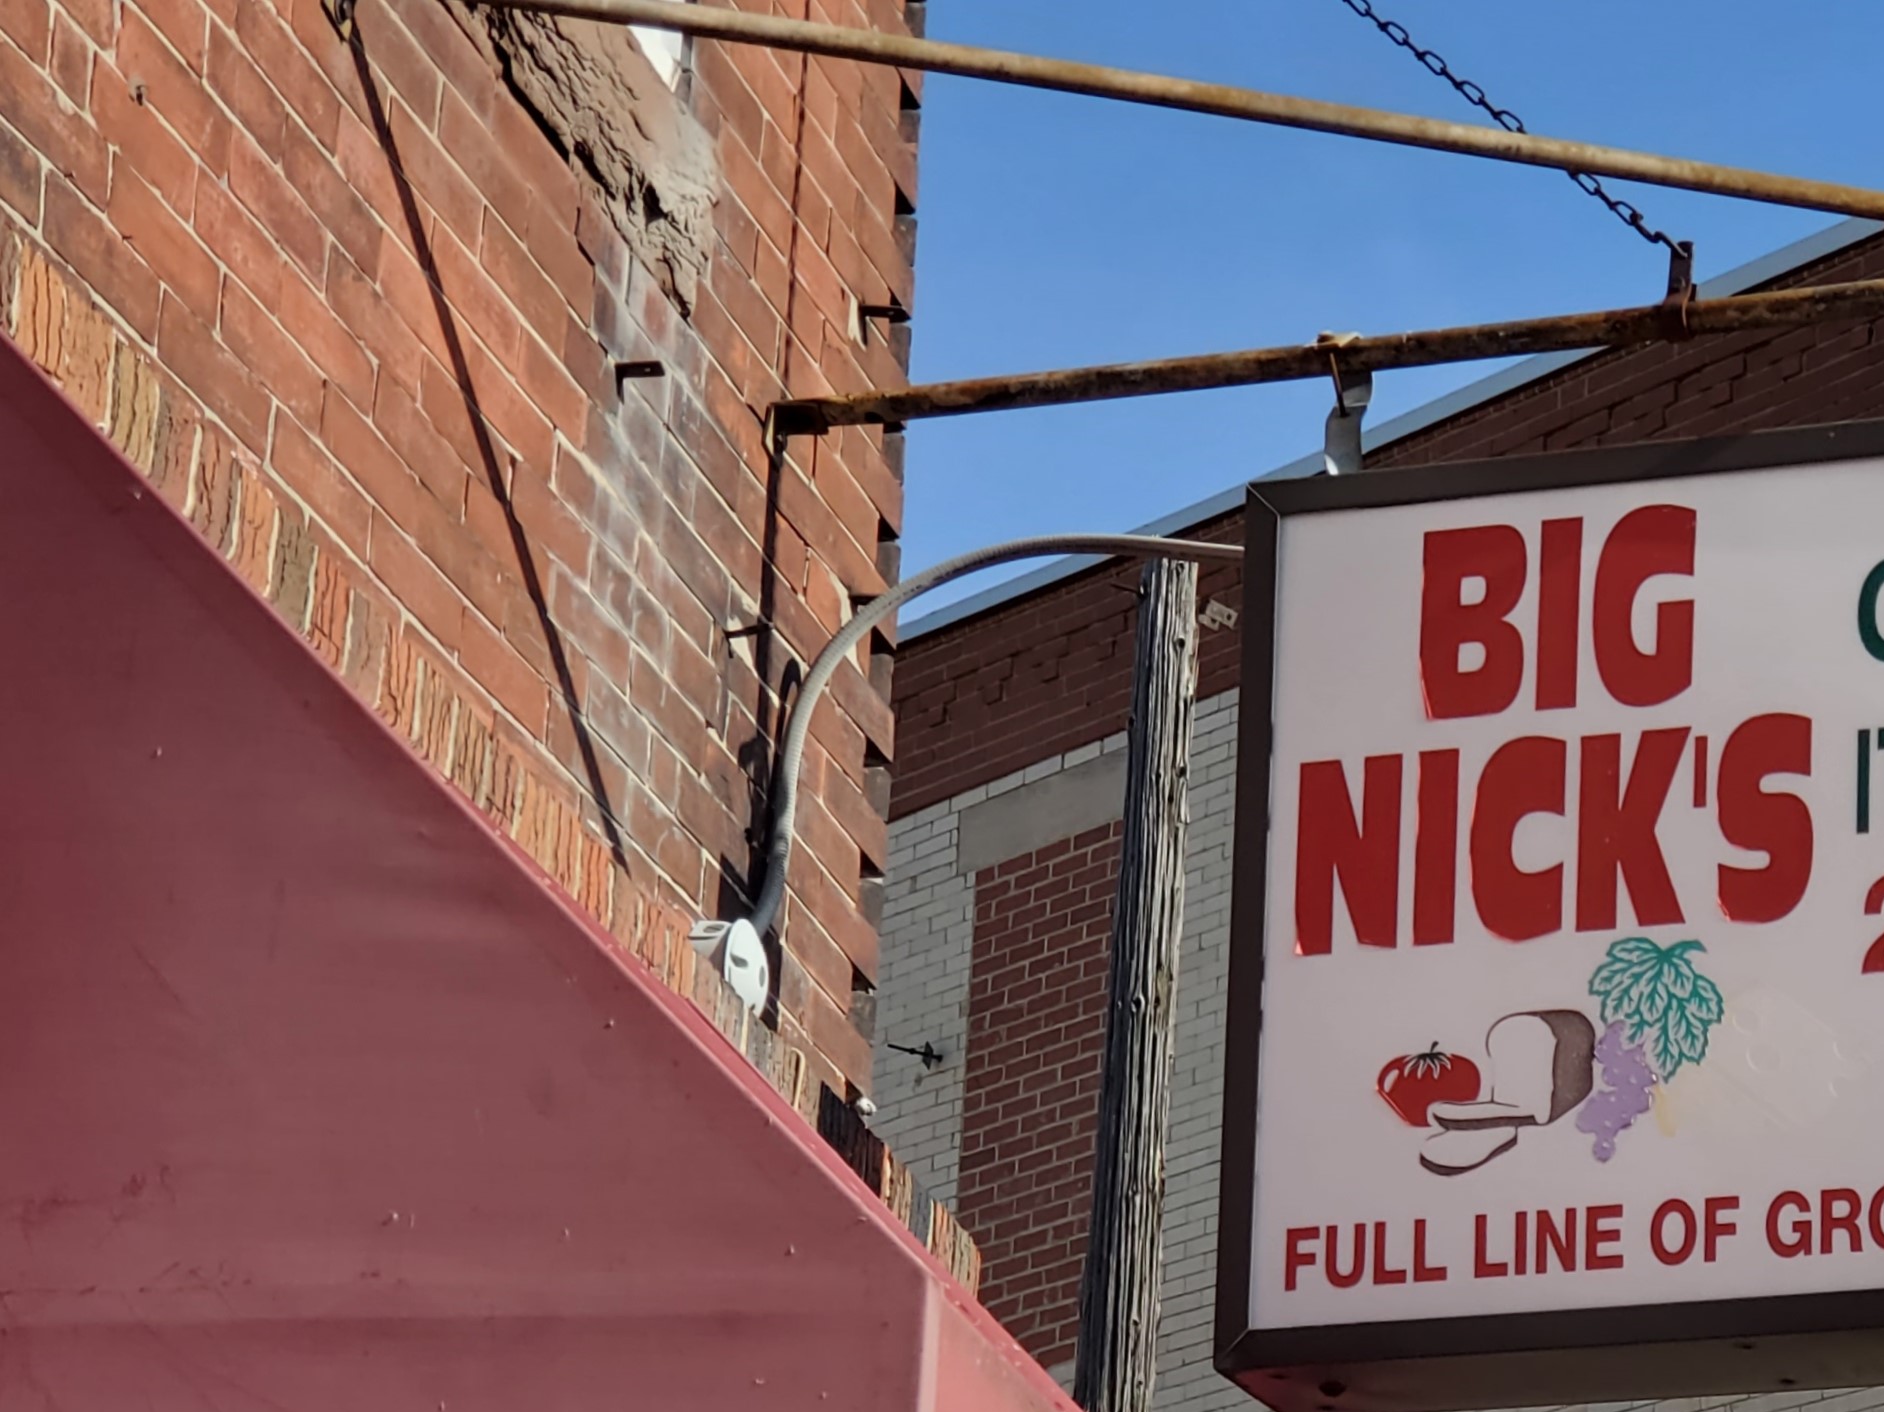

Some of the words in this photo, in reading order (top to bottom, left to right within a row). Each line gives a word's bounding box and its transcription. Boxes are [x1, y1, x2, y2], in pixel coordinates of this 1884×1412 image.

[1419, 504, 1697, 721] BIG
[1294, 712, 1814, 955] NICK'S
[1284, 1219, 1447, 1292] FULL
[1473, 1205, 1624, 1279] LINE
[1649, 1197, 1740, 1266] OF
